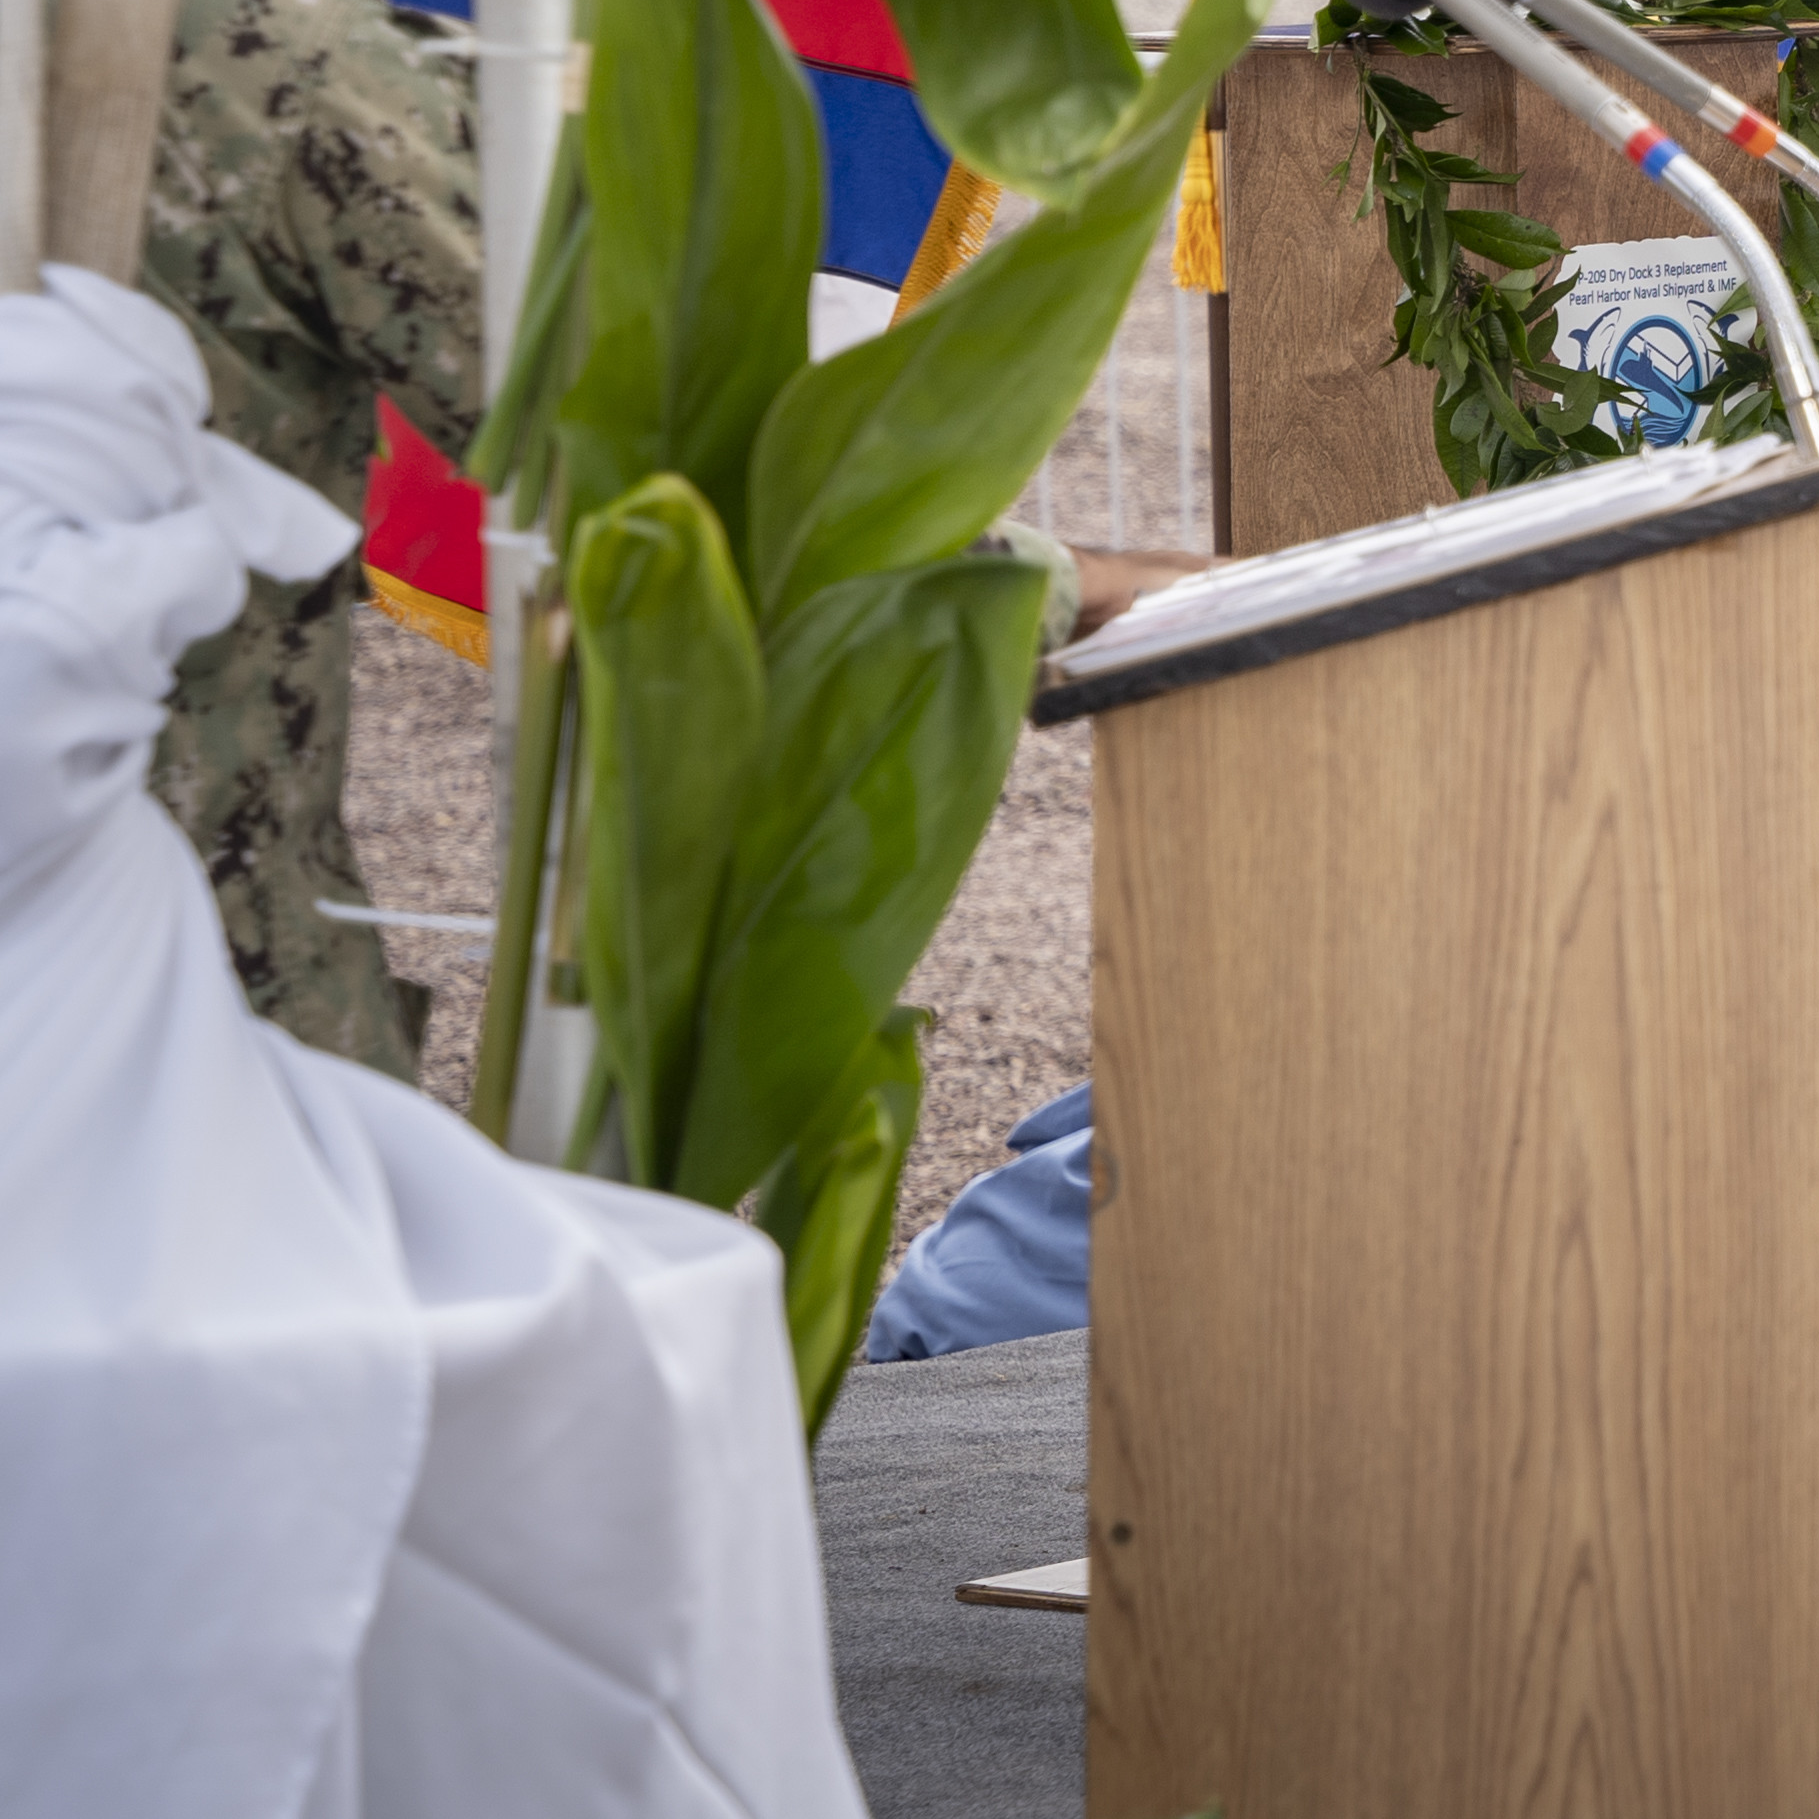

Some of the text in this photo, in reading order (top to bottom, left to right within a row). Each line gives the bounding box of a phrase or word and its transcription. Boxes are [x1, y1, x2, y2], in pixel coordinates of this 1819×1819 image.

[1578, 260, 1728, 285] P-209 Dry Dock 3 Replacement
[1569, 277, 1737, 306] Pearl Harbor Naval Shipyard & IMF
